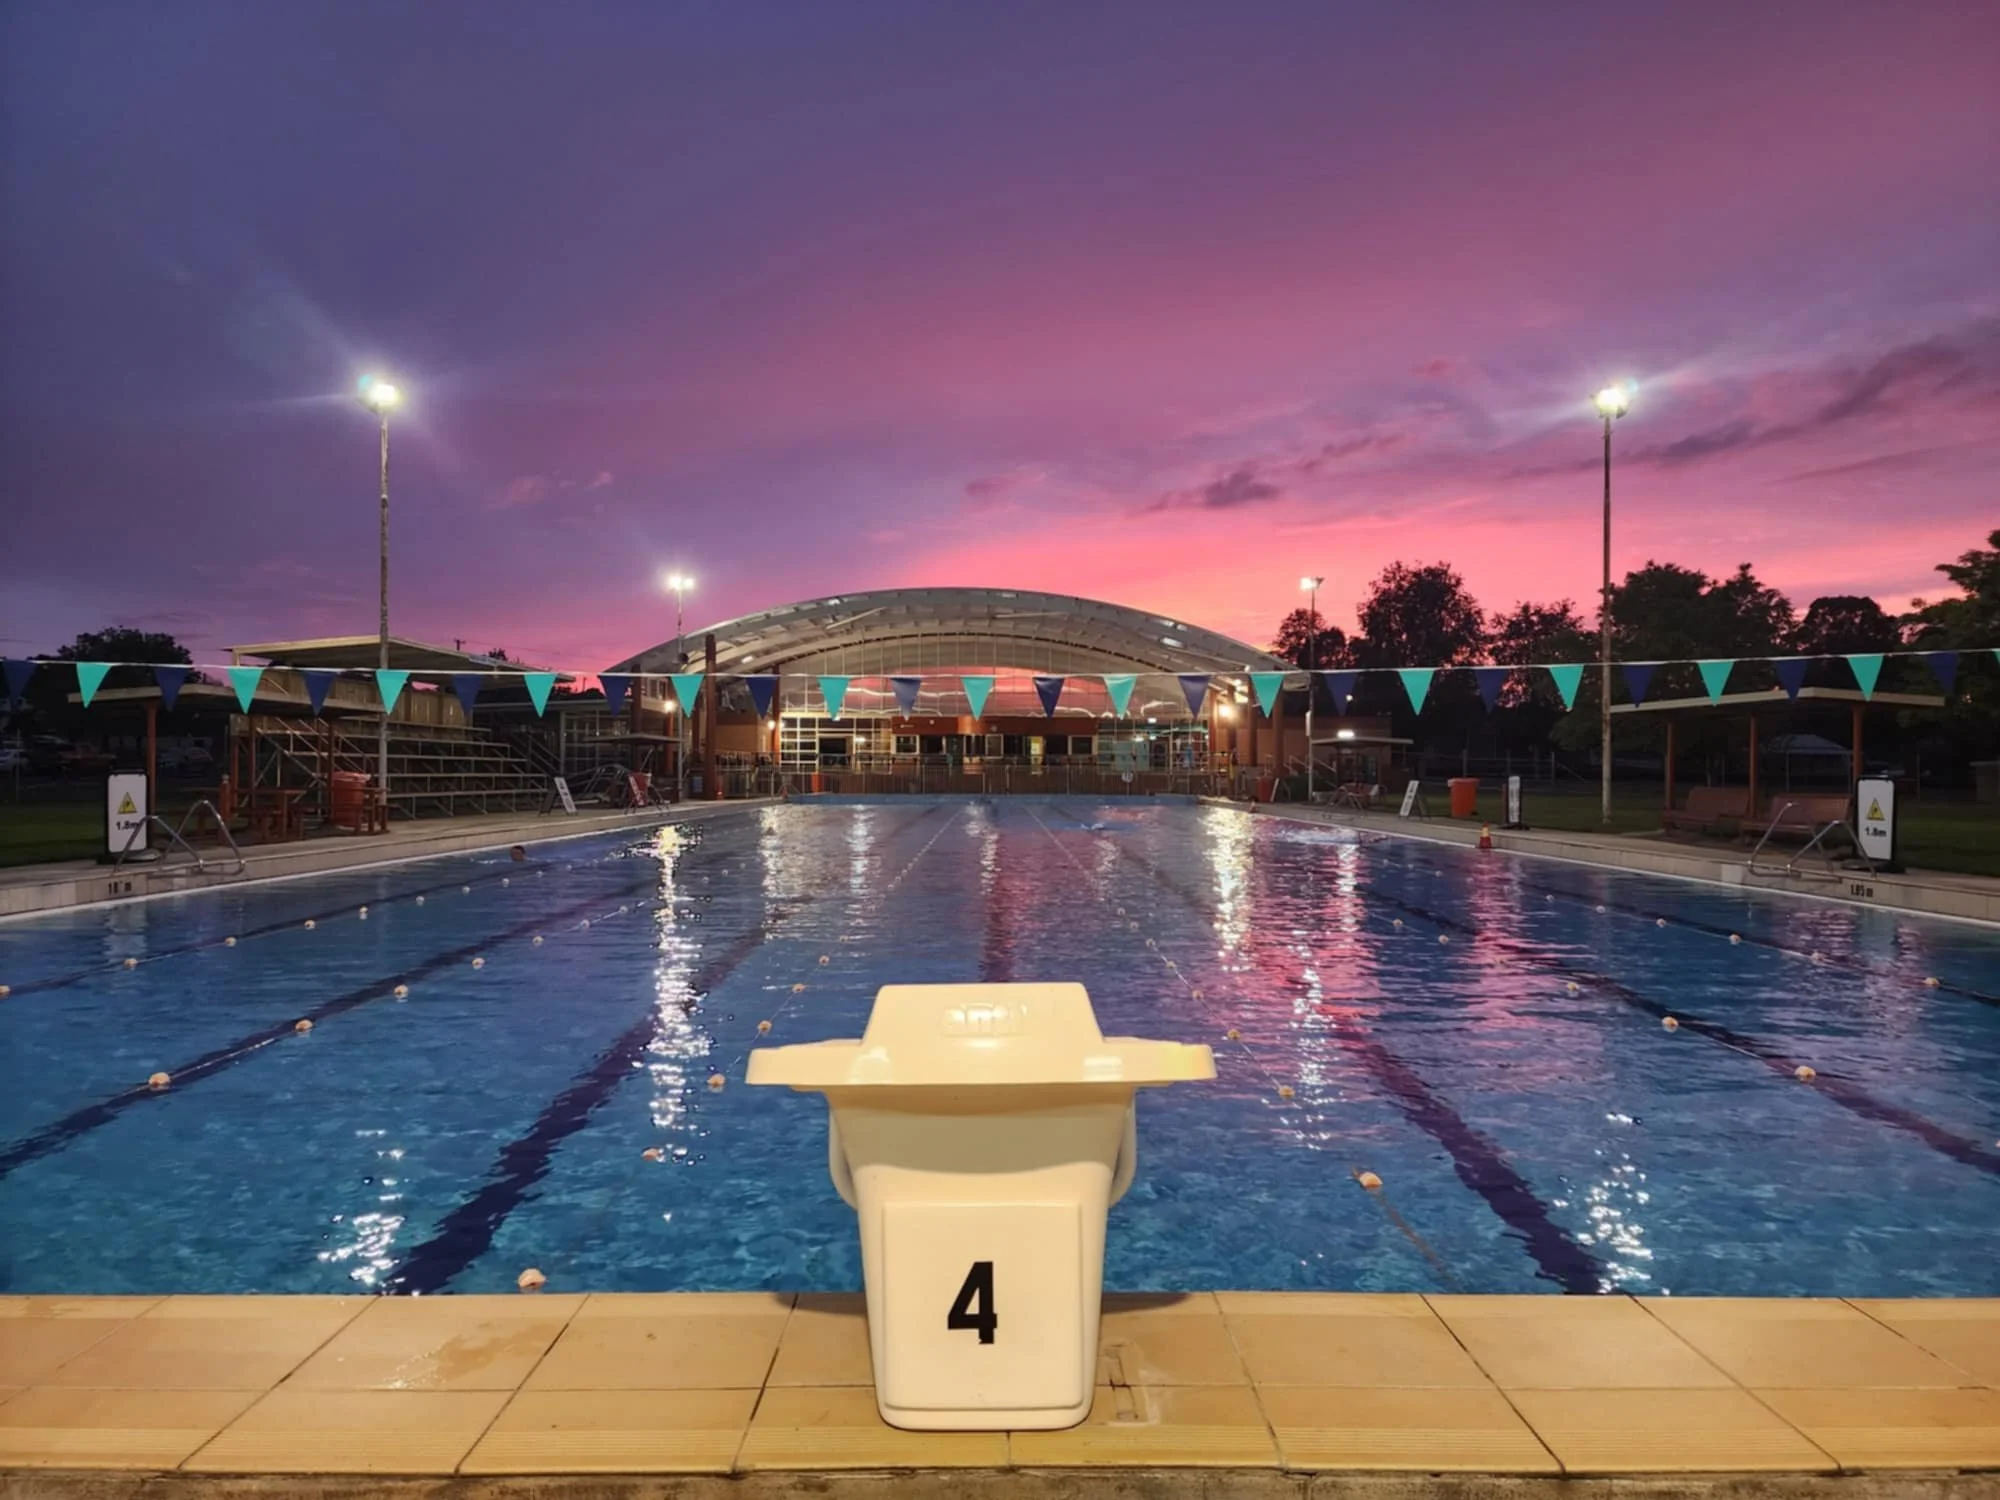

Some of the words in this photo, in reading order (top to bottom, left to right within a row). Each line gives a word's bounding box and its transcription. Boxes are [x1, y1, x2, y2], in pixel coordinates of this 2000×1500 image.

[116, 820, 140, 830] 1.8m
[1864, 826, 1887, 836] 1.8m
[947, 1261, 998, 1345] 4
